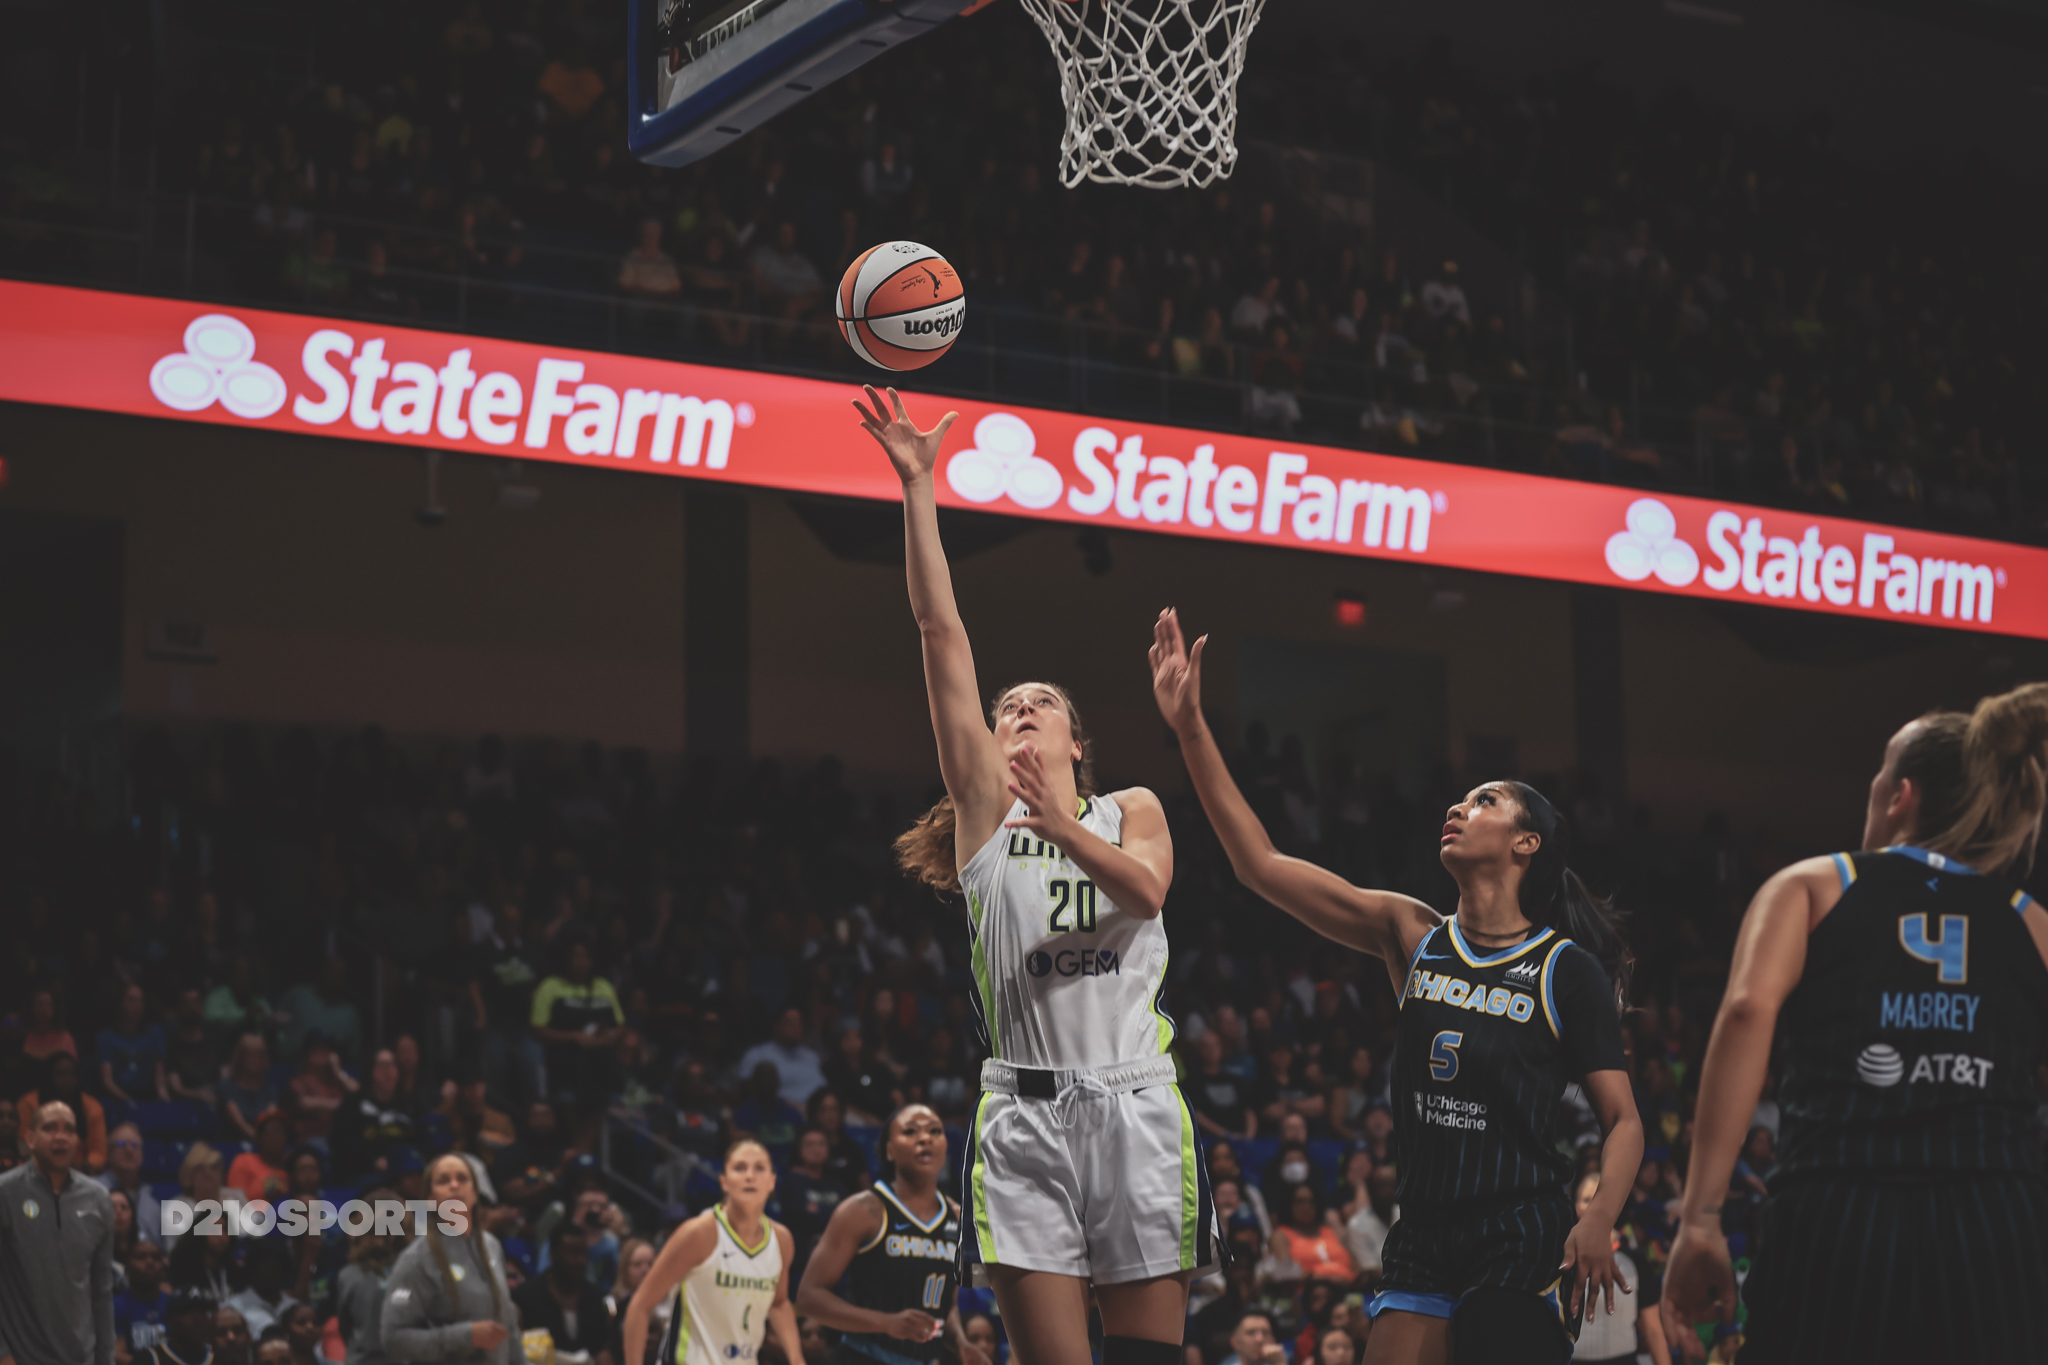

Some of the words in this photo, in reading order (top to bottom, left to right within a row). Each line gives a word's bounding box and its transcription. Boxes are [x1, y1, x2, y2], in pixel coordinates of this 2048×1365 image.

[904, 306, 964, 338] Wilson
[1047, 877, 1099, 935] 20
[1055, 948, 1120, 977] GEM
[1898, 911, 1969, 985] 4
[1407, 969, 1536, 1024] CHICAGO
[1880, 991, 1981, 1032] MABREY
[1429, 1030, 1464, 1082] 5
[1909, 1053, 1994, 1089] AT&T
[1426, 1109, 1487, 1131] Medicine
[922, 1272, 946, 1309] 11
